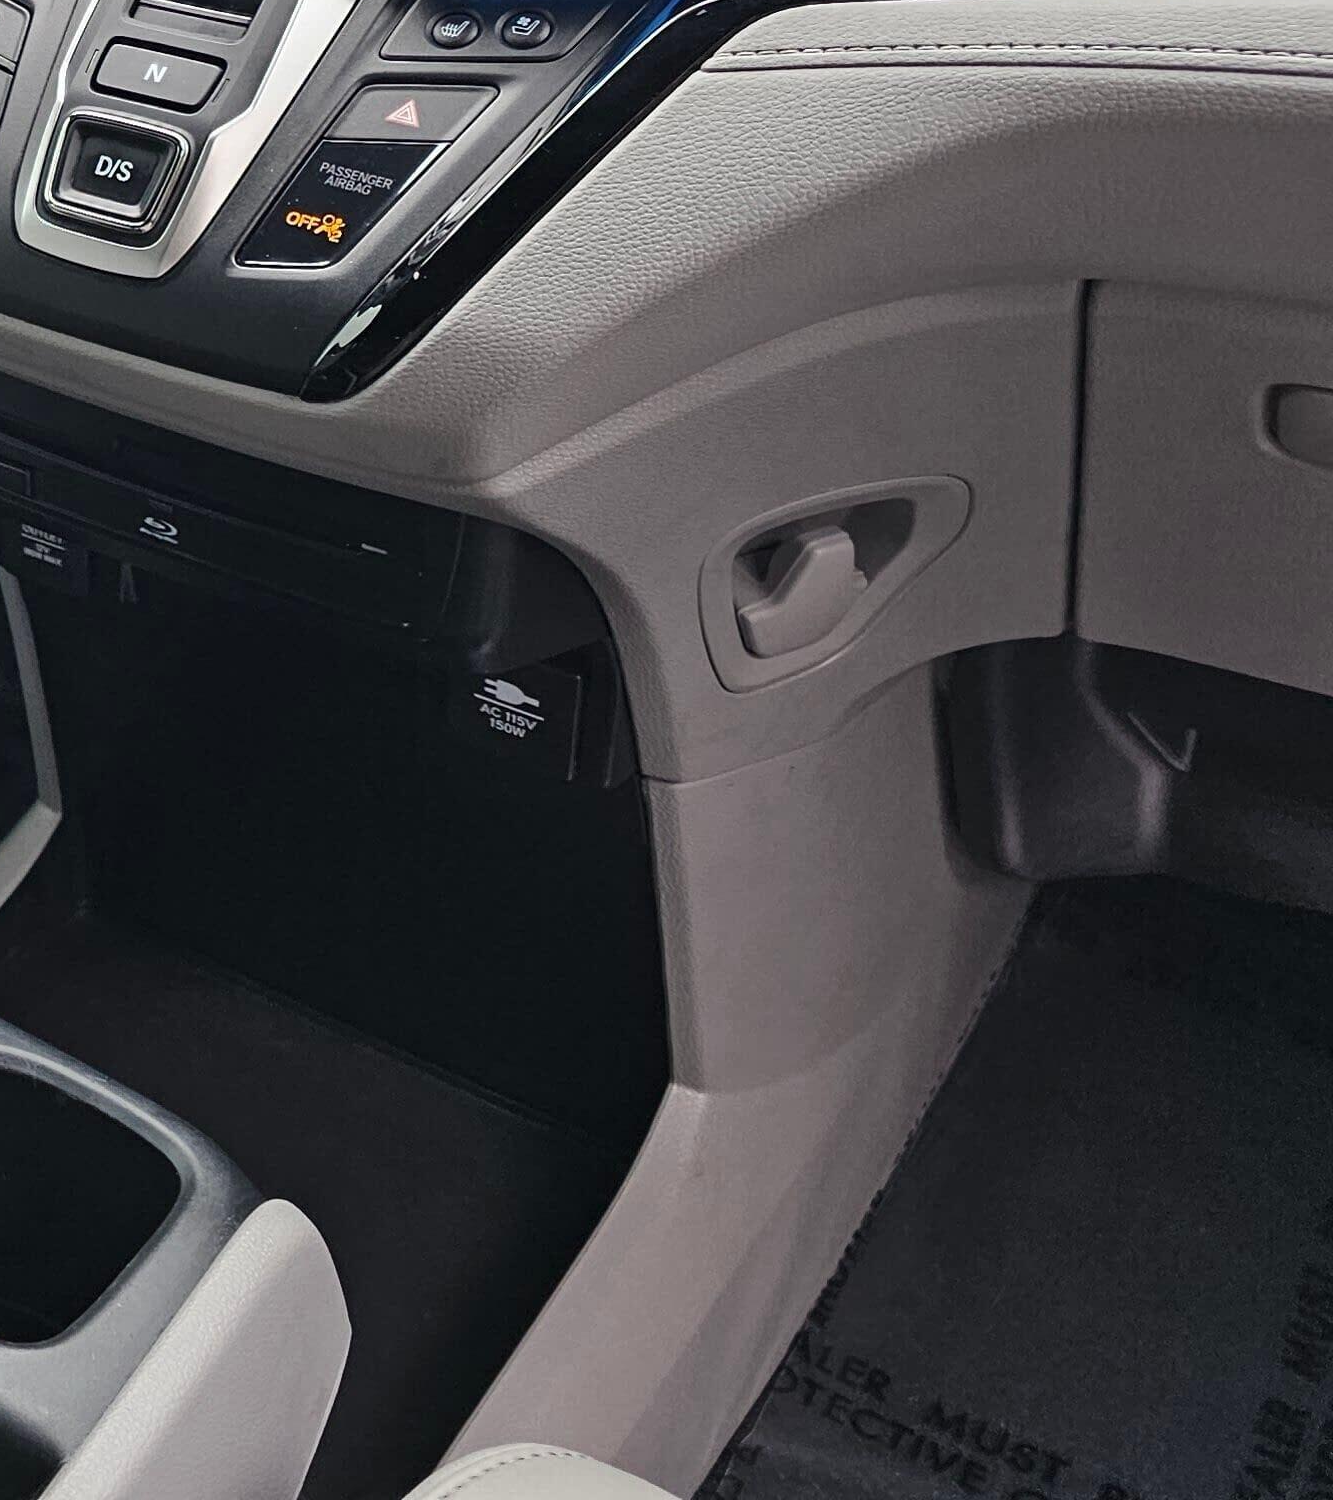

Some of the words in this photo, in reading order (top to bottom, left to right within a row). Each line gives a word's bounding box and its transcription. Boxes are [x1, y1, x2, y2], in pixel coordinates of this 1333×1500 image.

[143, 63, 167, 83] N
[94, 154, 134, 183] D/S
[319, 162, 393, 190] PASSENGER
[324, 175, 372, 195] AIRBAG
[286, 211, 321, 230] OFF
[479, 703, 501, 718] AC
[505, 711, 537, 730] 115V
[489, 717, 526, 738] 150W
[797, 1331, 891, 1402] ALER
[921, 1399, 1072, 1486] MUST
[772, 1365, 989, 1495] OTECTIVE
